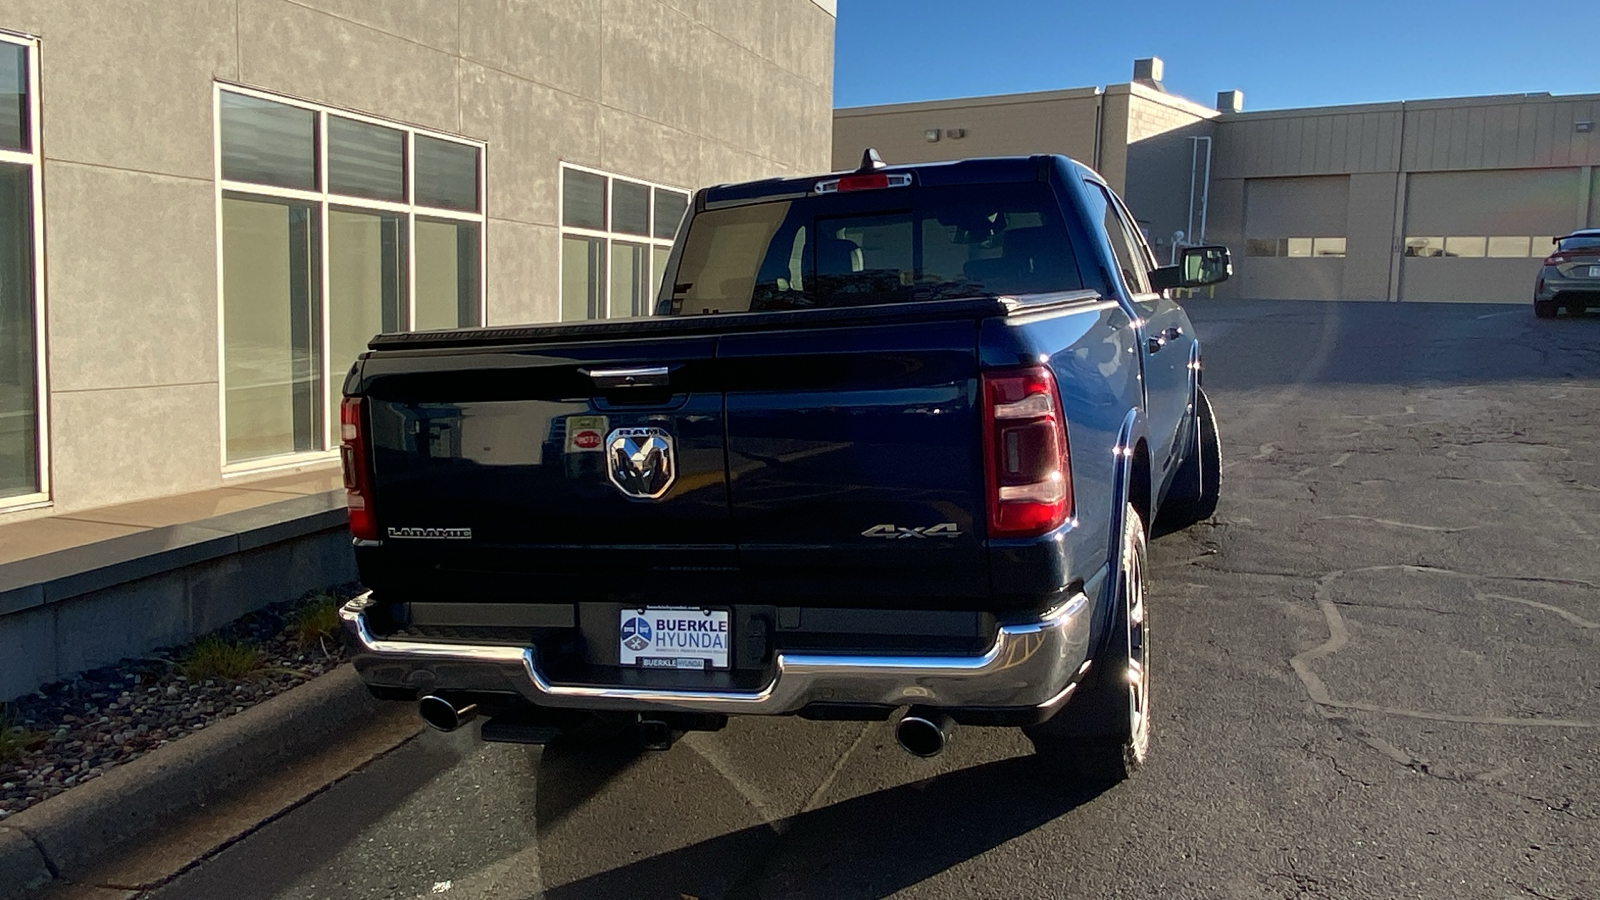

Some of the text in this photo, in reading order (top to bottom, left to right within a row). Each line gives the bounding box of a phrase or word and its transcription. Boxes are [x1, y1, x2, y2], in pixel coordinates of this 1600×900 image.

[388, 527, 471, 538] LARAMIE
[656, 619, 727, 632] BUERKLE
[655, 632, 727, 648] HYUNDAI
[643, 659, 676, 667] BUERKLE
